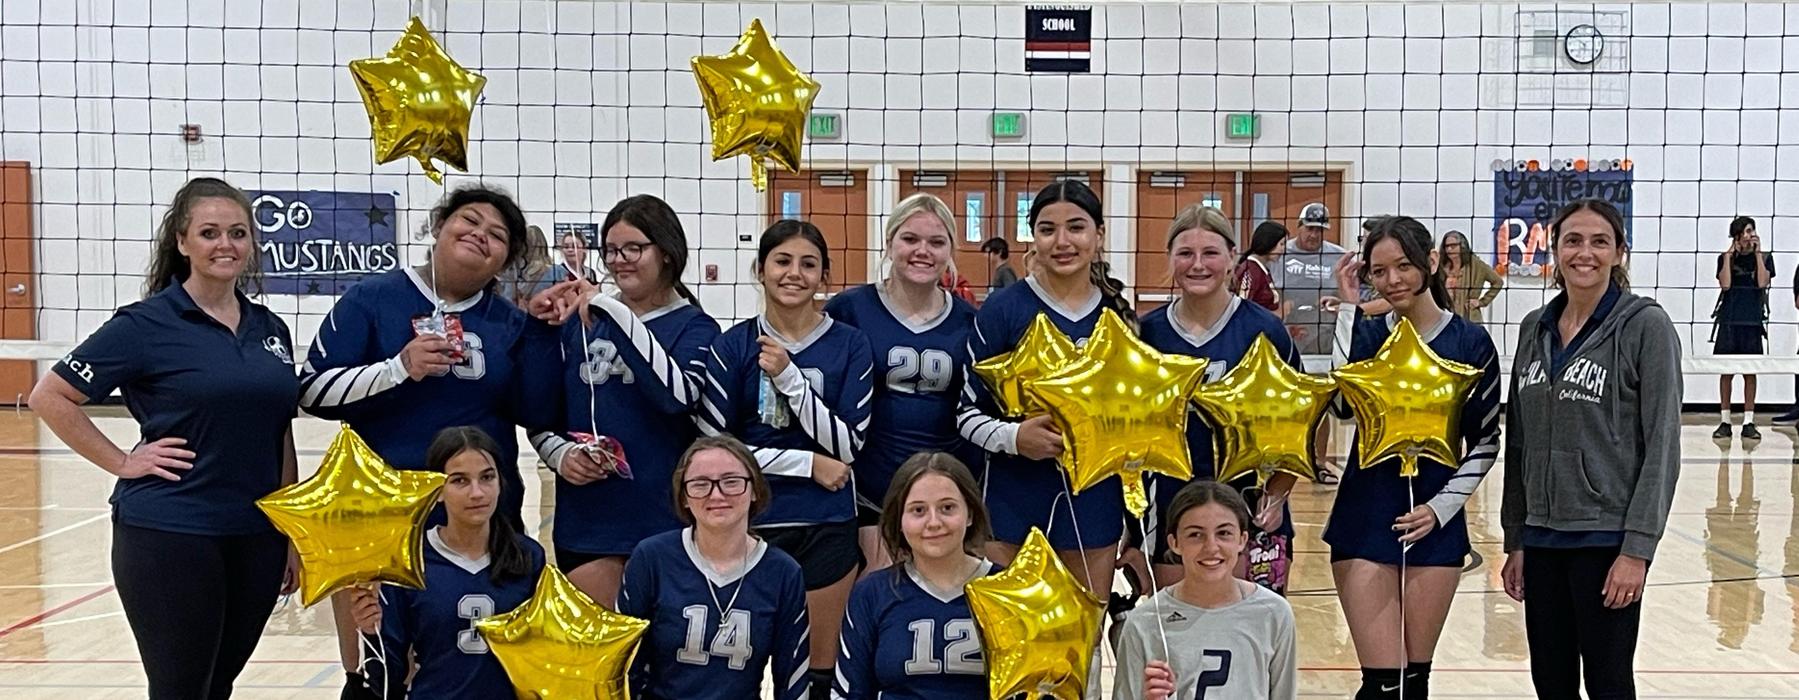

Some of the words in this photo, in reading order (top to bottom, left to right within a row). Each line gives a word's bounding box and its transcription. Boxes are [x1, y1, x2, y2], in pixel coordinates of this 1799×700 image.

[1042, 18, 1076, 31] SCHOOL
[812, 115, 836, 135] EXIT
[252, 195, 312, 233] GO
[259, 239, 397, 271] MUSTANGS
[886, 345, 953, 394] 29
[1563, 358, 1607, 396] BEACH
[1559, 389, 1601, 404] California
[676, 604, 753, 671] 14
[904, 618, 986, 676] 12
[1194, 648, 1232, 700] 2
